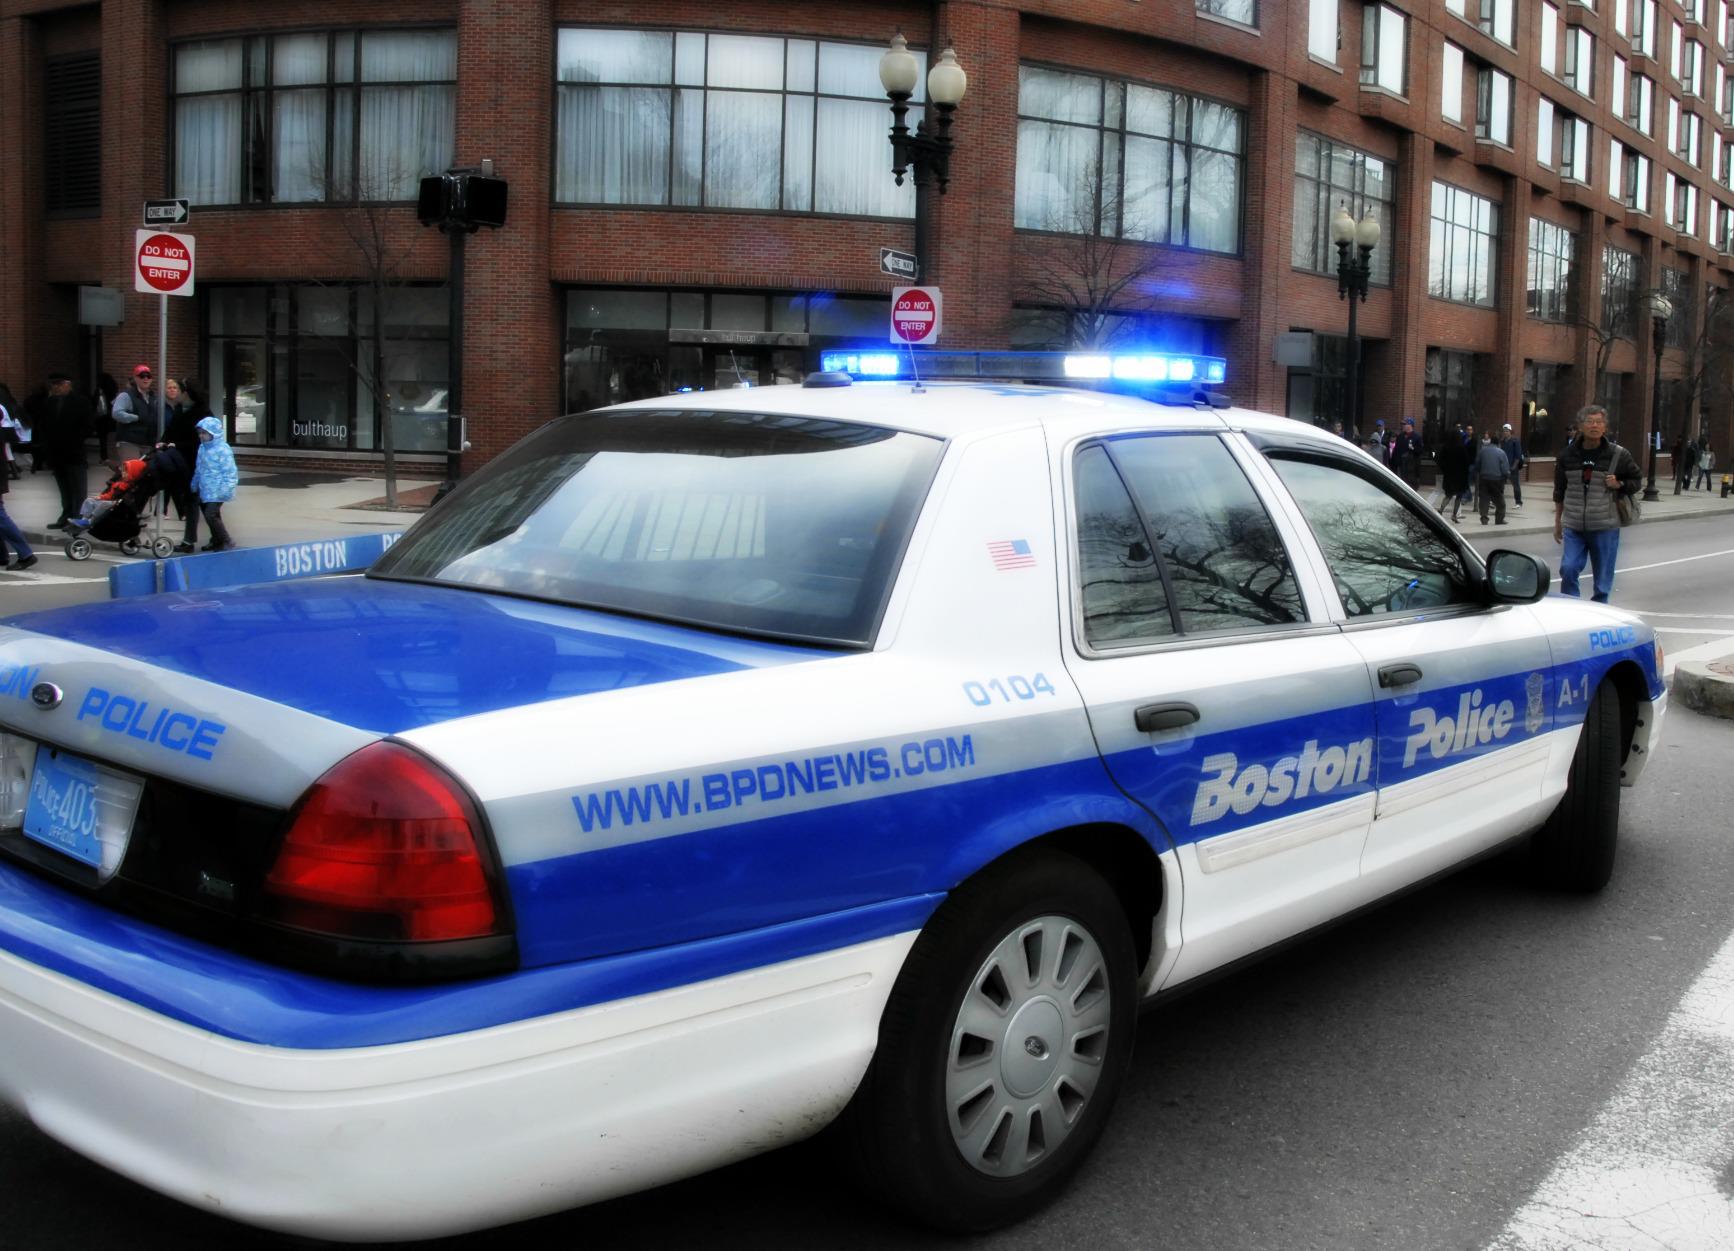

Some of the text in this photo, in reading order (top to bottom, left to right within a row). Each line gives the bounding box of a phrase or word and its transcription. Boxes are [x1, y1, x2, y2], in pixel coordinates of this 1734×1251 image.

[149, 207, 176, 217] ONE WAY
[145, 245, 185, 258] DO NOT
[149, 268, 180, 280] ENTER
[903, 261, 913, 270] WAY
[898, 301, 931, 310] DO NOT
[900, 321, 926, 331] ENTER
[293, 420, 347, 440] bulthaup
[275, 540, 347, 577] BOSTON
[962, 671, 1056, 707] 0104
[1558, 673, 1589, 709] A-1
[76, 686, 227, 761] POLICE
[1190, 735, 1373, 827] Boston
[1402, 688, 1515, 768] Police
[571, 733, 976, 833] WWW.BPDNEWS.COM
